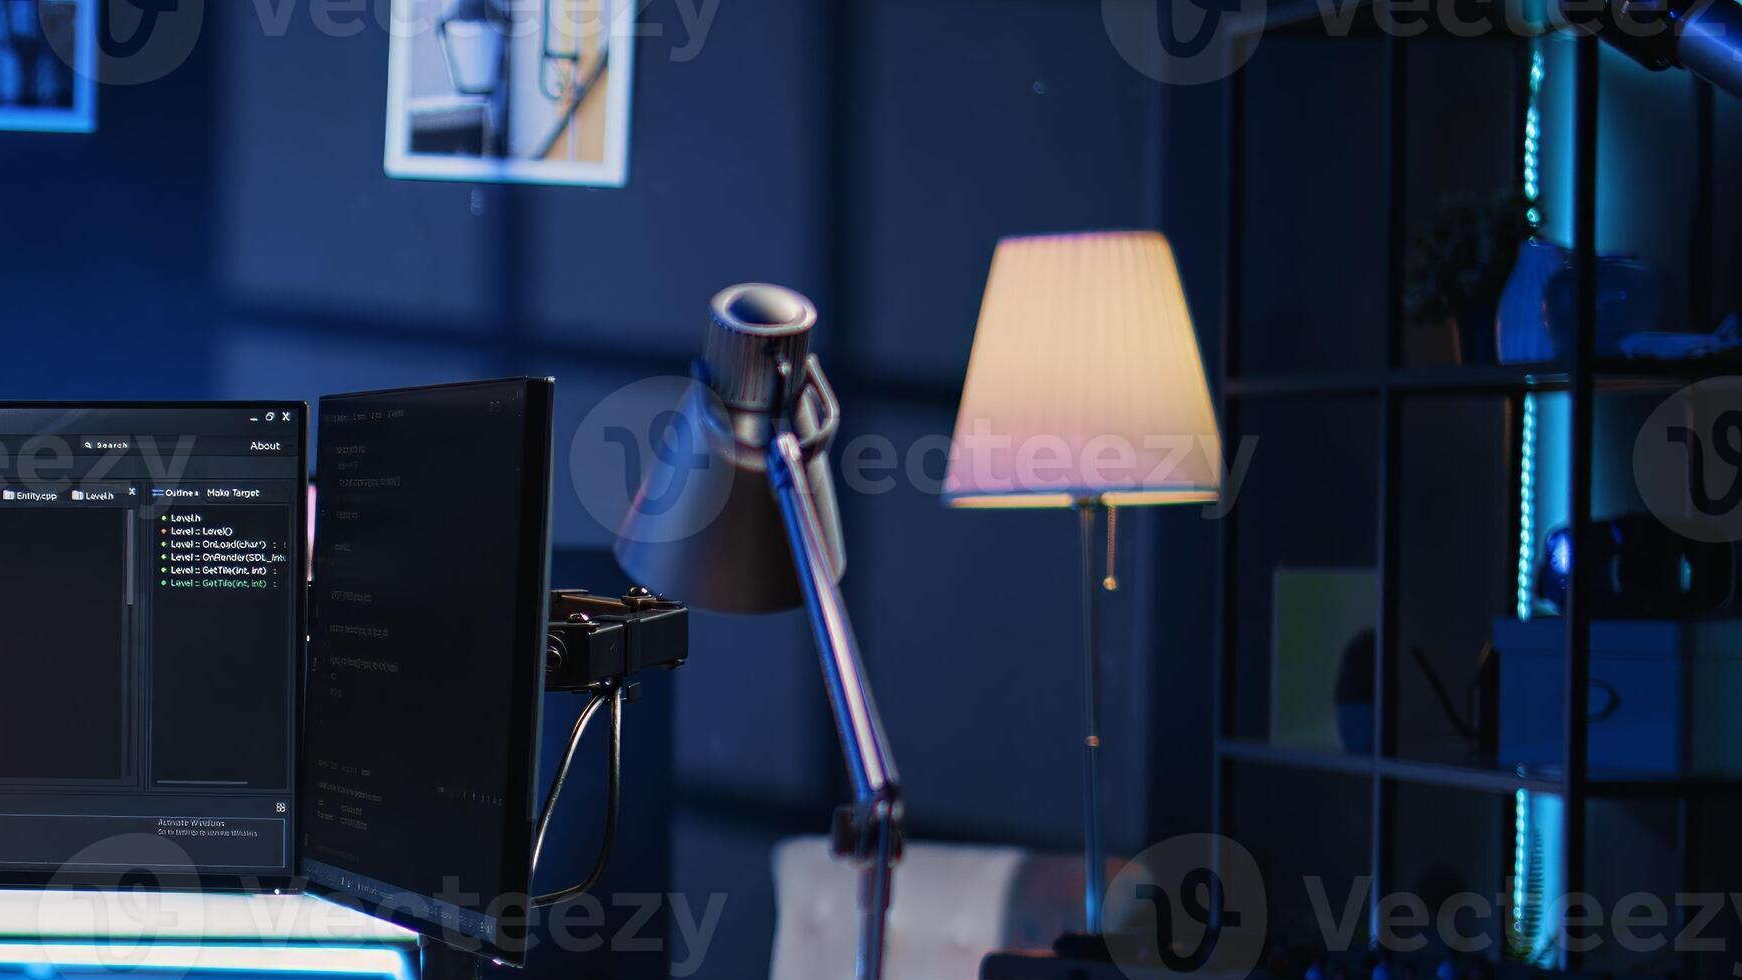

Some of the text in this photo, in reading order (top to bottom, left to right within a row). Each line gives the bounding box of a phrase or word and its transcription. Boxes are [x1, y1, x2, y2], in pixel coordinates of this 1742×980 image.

[96, 441, 128, 449] Search
[250, 441, 281, 451] About
[16, 491, 57, 501] Entity.cpp
[85, 491, 114, 500] Level.h
[207, 488, 260, 499] Make Target
[170, 527, 194, 536] Level
[170, 540, 194, 549] Level
[170, 553, 194, 562] Level
[170, 565, 194, 575] Level
[170, 579, 194, 588] Level
